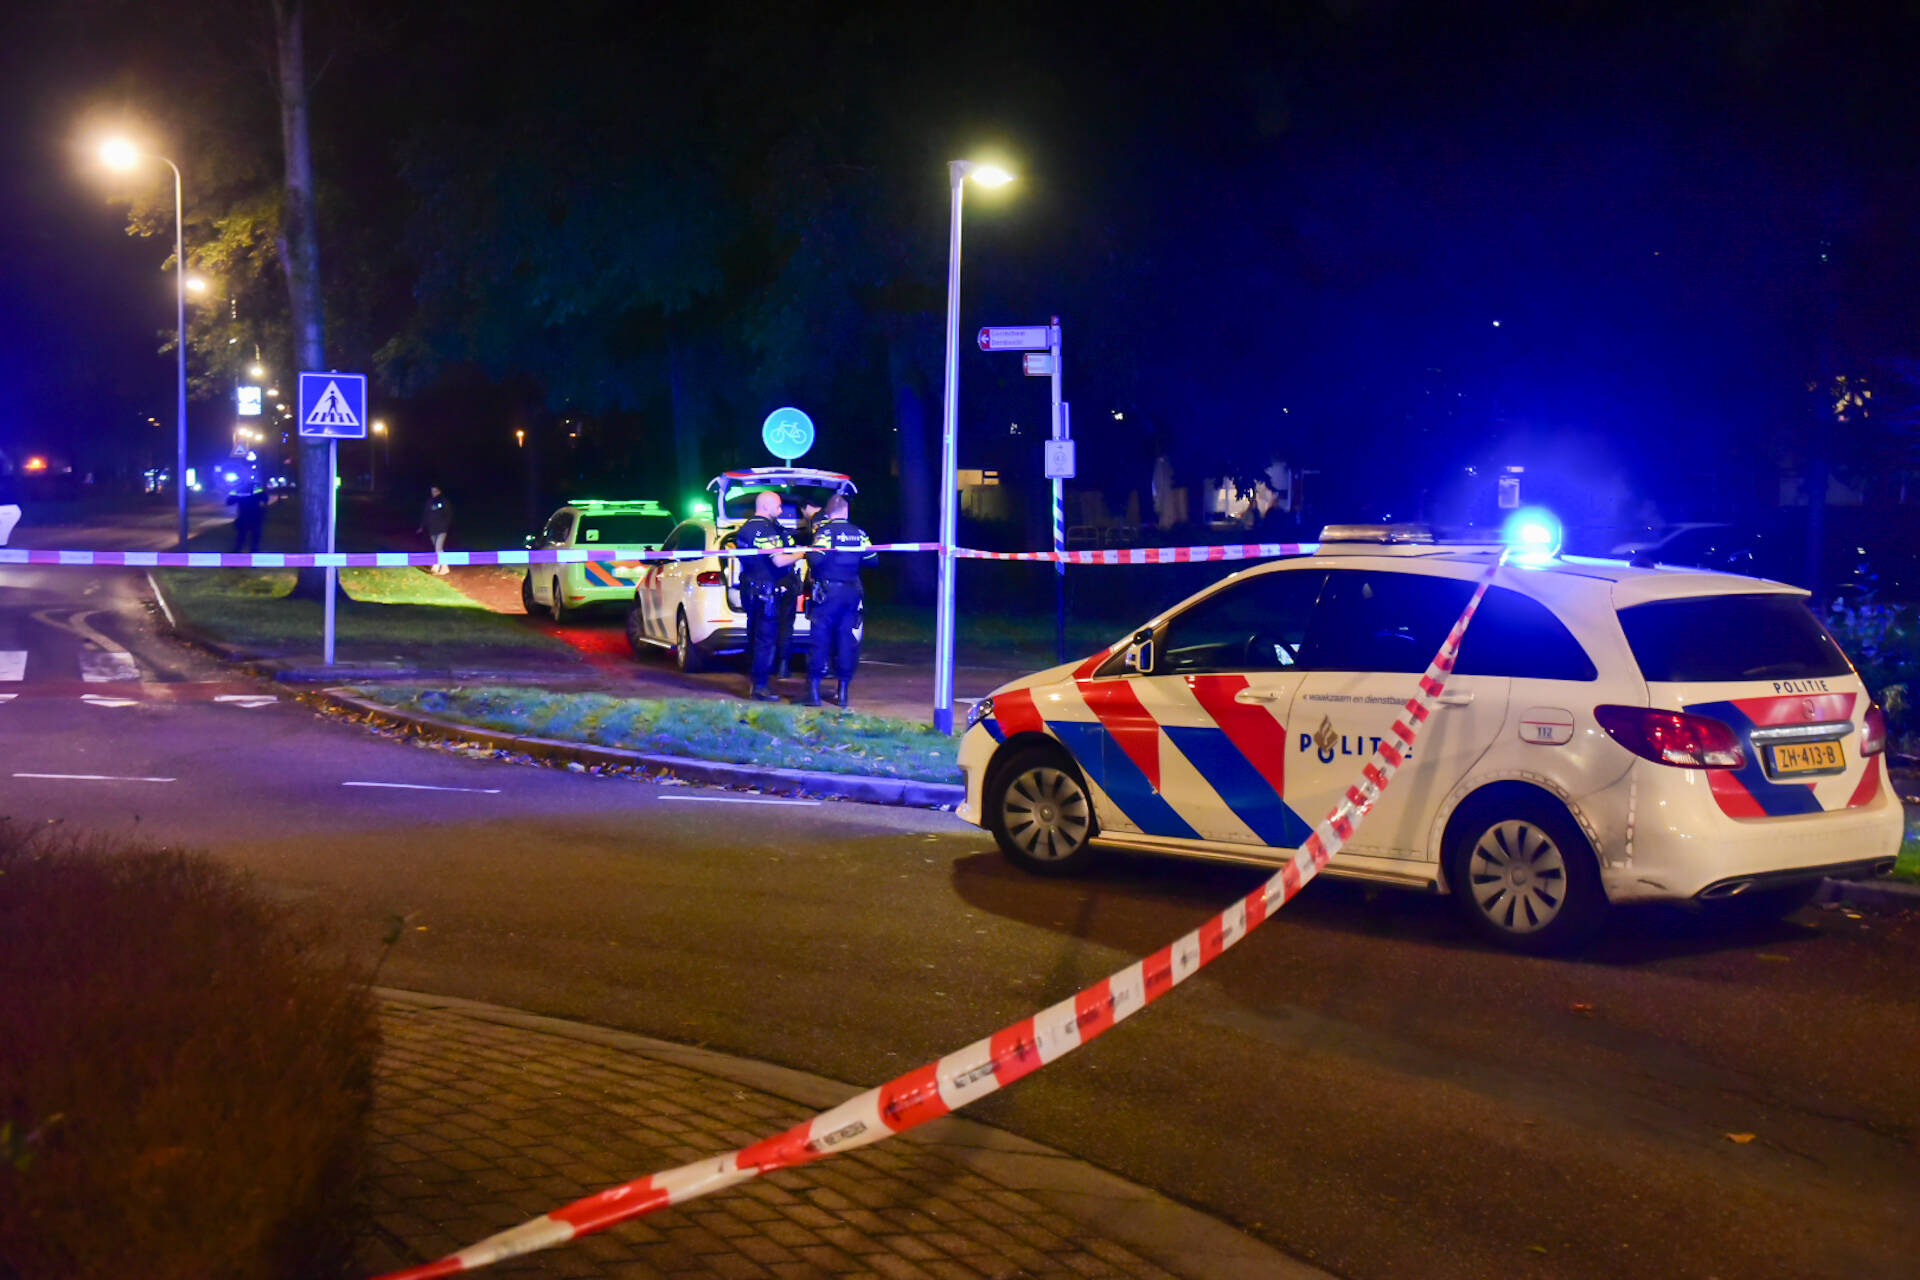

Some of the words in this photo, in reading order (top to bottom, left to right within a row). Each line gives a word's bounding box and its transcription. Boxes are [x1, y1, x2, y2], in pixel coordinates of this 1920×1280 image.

[1773, 680, 1829, 694] POLITIE
[1300, 733, 1413, 764] POLIT
[1780, 746, 1836, 768] ZH-413-B
